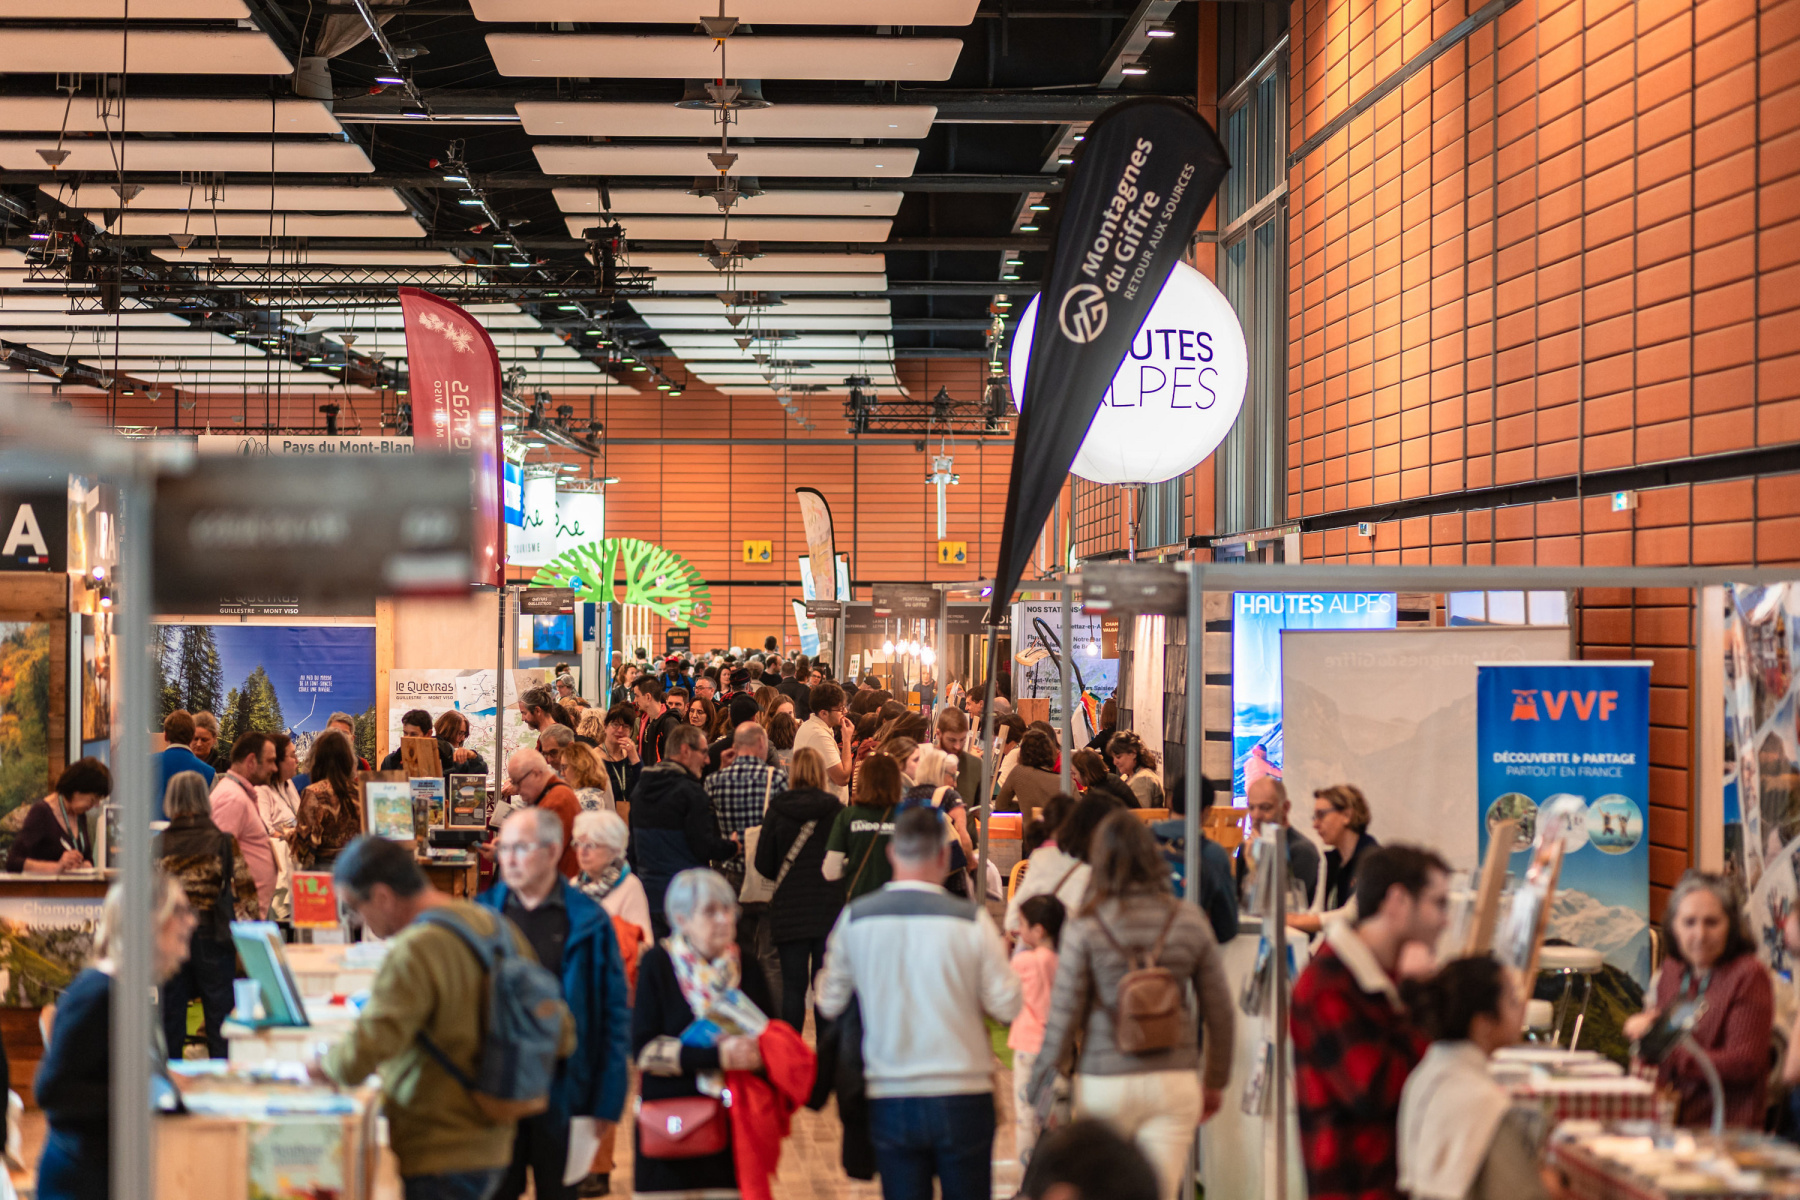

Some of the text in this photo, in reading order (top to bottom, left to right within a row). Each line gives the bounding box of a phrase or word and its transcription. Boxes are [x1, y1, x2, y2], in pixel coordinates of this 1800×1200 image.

[1082, 137, 1153, 279] Montagnes
[1106, 189, 1161, 293] du Giffre
[1123, 161, 1196, 301] RETOUR AUX SOURCES
[1124, 328, 1214, 363] UTES
[1099, 365, 1219, 410] LPES
[283, 440, 316, 457] Pays
[318, 440, 337, 454] du
[2, 503, 49, 556] A
[1239, 593, 1391, 614] HAUTES ALPES
[396, 681, 405, 691] le
[1541, 690, 1619, 721] VVF
[1493, 750, 1570, 763] DÉCOUVERTE
[1582, 753, 1636, 764] PARTAGE
[1506, 765, 1623, 778] PARTOUT EN FRANCE
